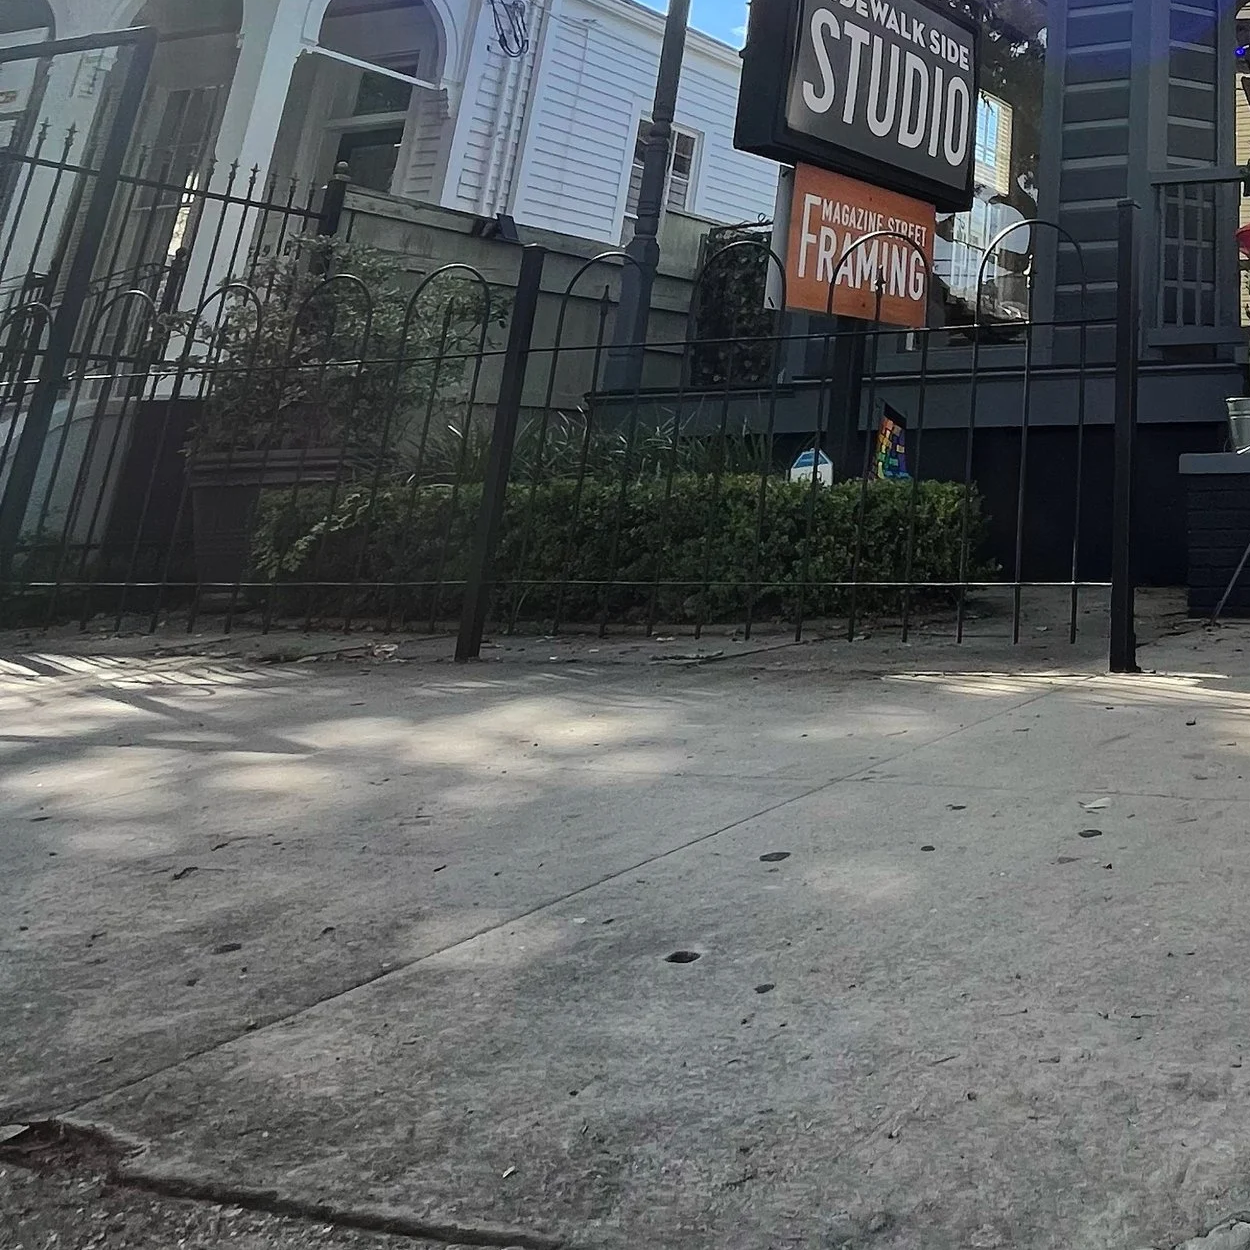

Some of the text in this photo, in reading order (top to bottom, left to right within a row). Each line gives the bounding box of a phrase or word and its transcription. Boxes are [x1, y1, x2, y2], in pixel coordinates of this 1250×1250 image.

[802, 8, 970, 167] STUDIO
[929, 29, 970, 71] SIDE
[798, 193, 925, 301] FRAMING
[821, 198, 927, 247] MAGAZINE STREET
